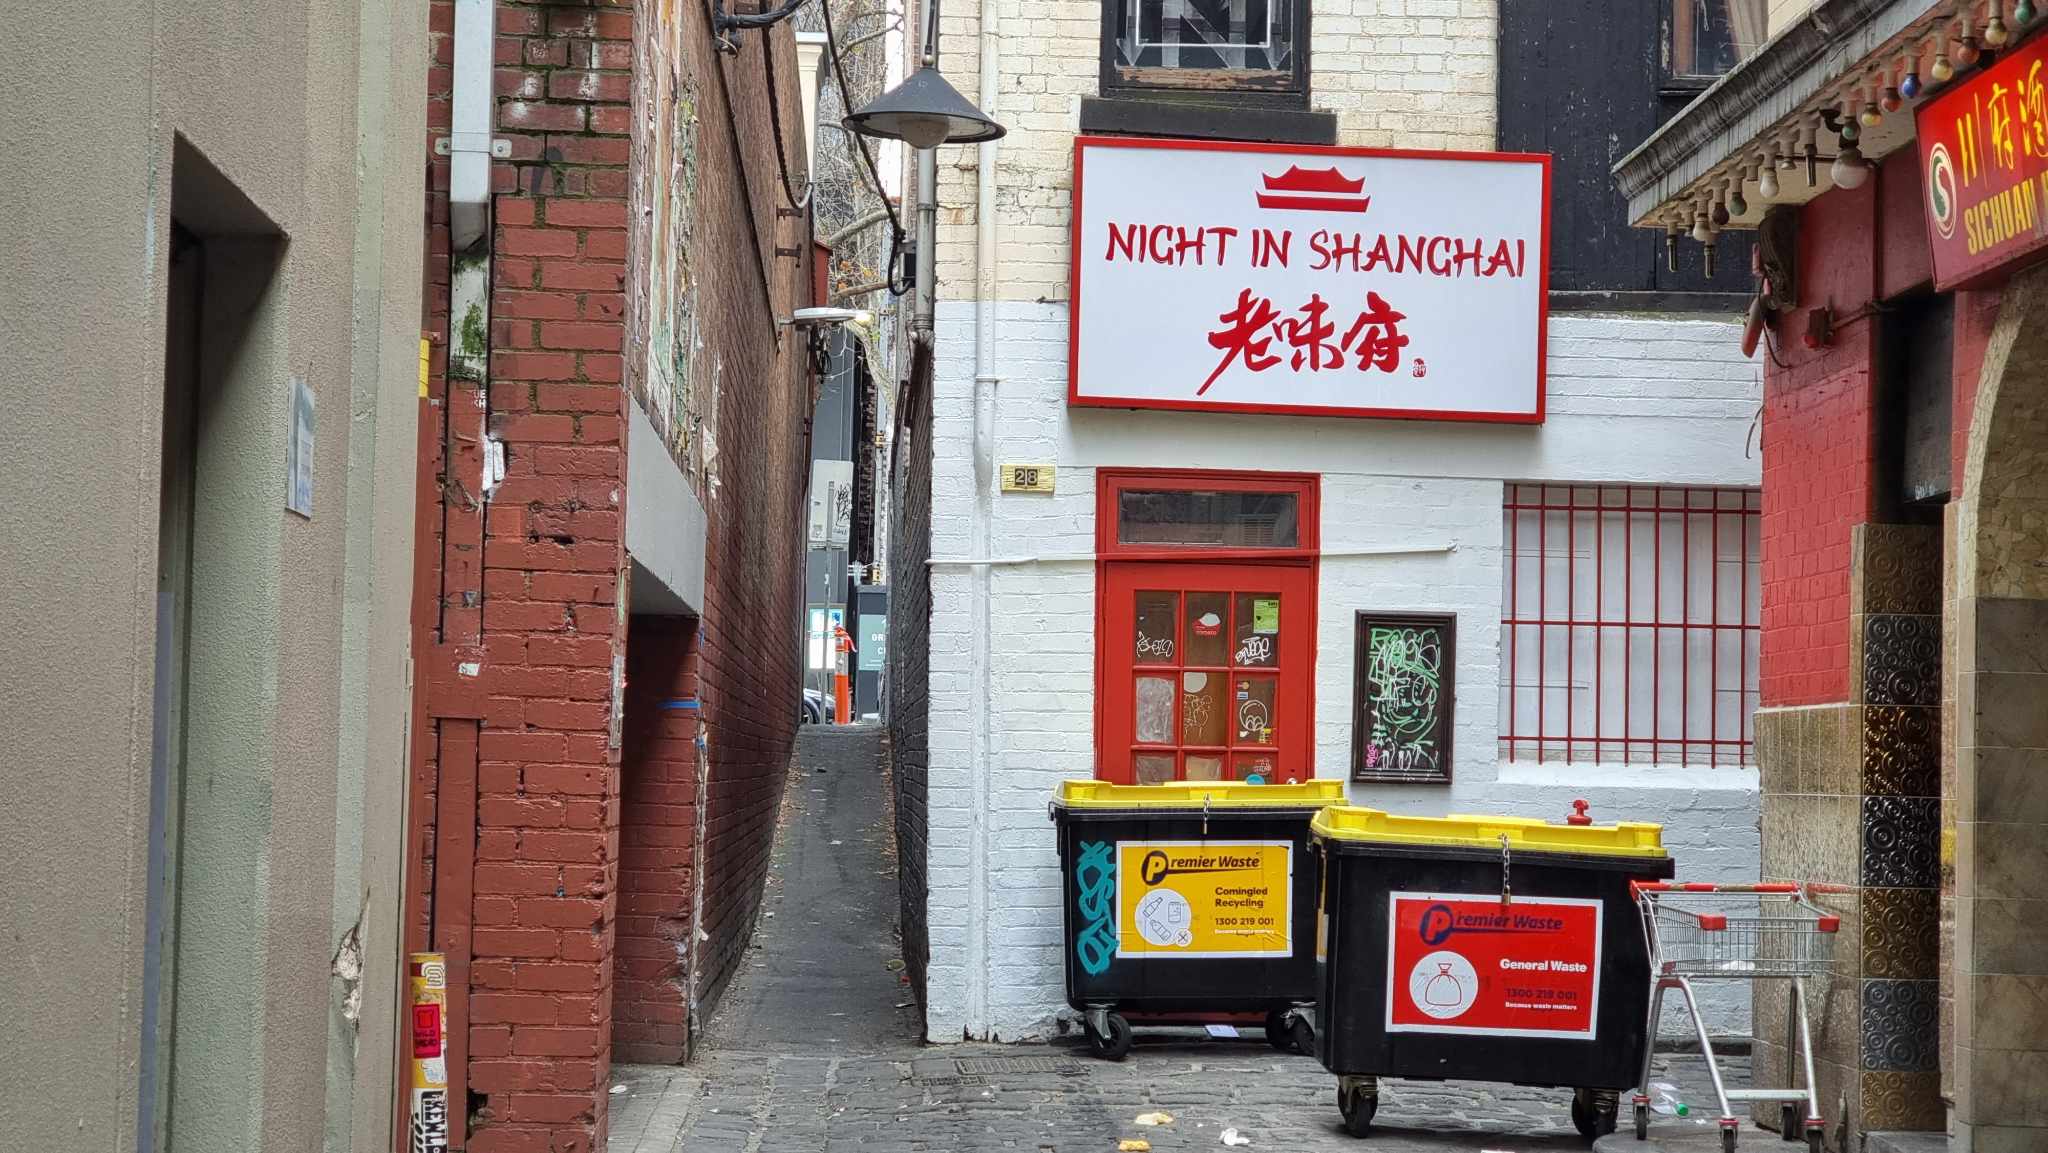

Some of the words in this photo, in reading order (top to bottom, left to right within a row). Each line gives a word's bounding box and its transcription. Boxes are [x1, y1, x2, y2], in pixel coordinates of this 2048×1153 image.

[1964, 178, 2041, 256] SICHUAN
[1105, 223, 1238, 265] NIGHT
[1251, 229, 1292, 268] IN
[1310, 232, 1525, 278] SHANGHAI
[1014, 468, 1038, 486] 28
[1141, 850, 1216, 886] Premier
[1218, 856, 1260, 868] Waste
[1215, 898, 1264, 909] Recycling
[1215, 917, 1238, 926] 1300
[1239, 917, 1256, 926] 219
[1257, 917, 1274, 926] 001
[1419, 904, 1510, 946] Premier
[1513, 914, 1563, 930] Waste
[1499, 958, 1549, 971] General
[1550, 960, 1588, 973] Waste
[1506, 988, 1533, 998] 1300
[1557, 991, 1577, 1000] 001
